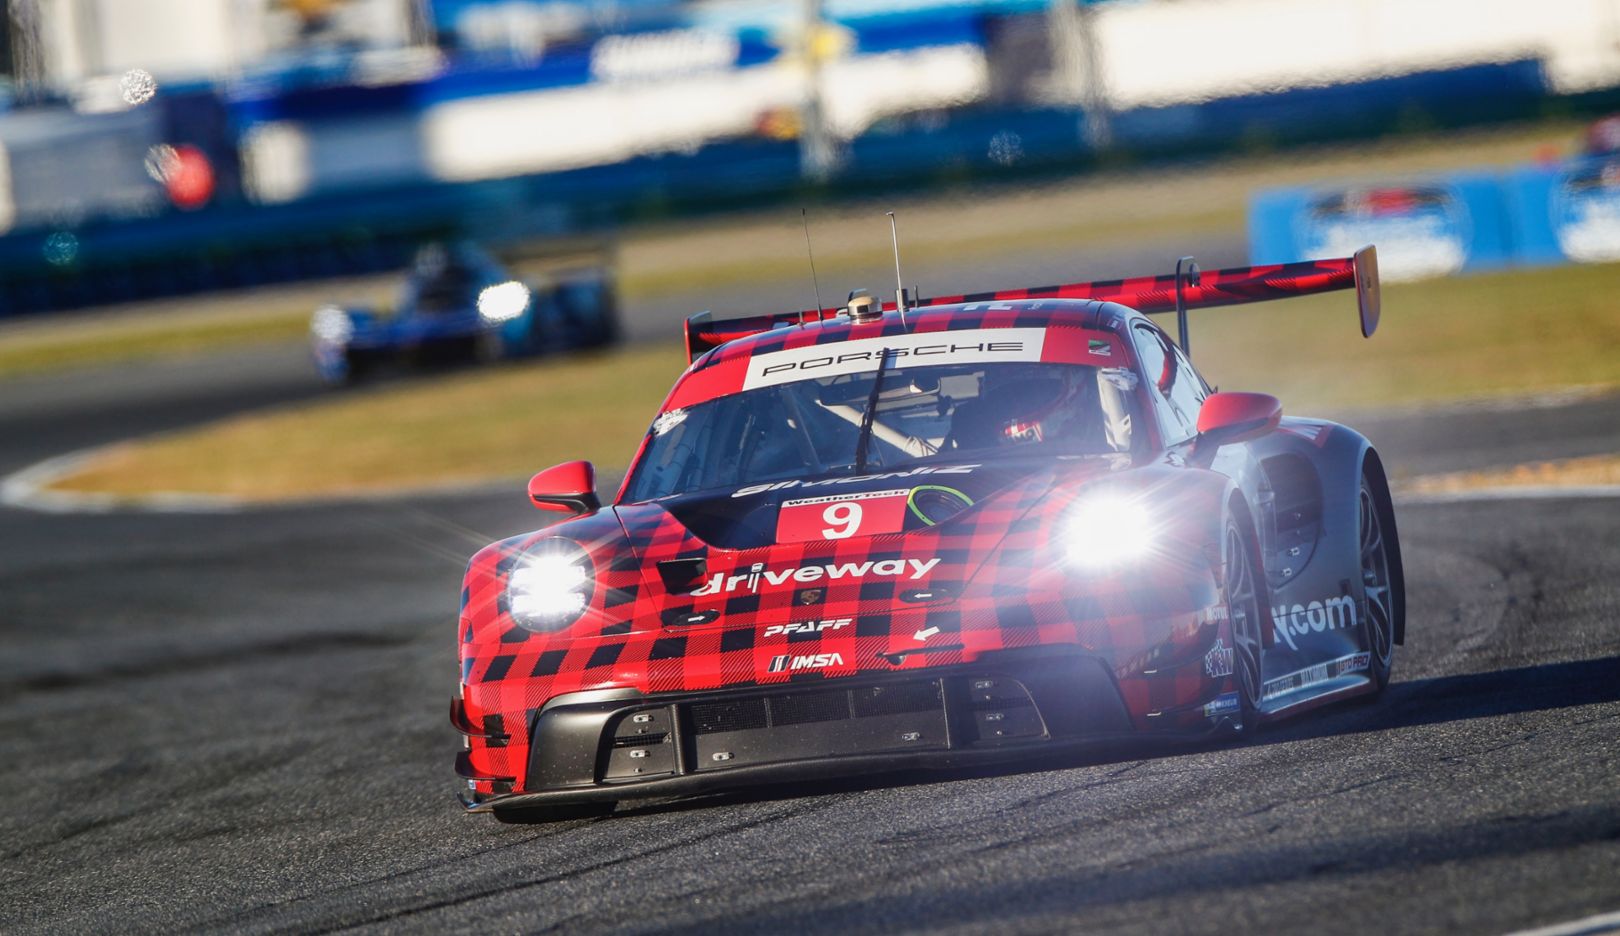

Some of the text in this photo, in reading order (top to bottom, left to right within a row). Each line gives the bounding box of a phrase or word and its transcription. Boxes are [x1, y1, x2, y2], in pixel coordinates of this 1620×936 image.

[762, 342, 1023, 376] PORSCHE
[787, 489, 907, 506] WeatherTech
[821, 502, 862, 540] 9
[690, 558, 942, 596] driveway
[764, 618, 853, 637] PFAFF
[1271, 595, 1357, 651] y.com
[791, 652, 844, 670] IMSA
